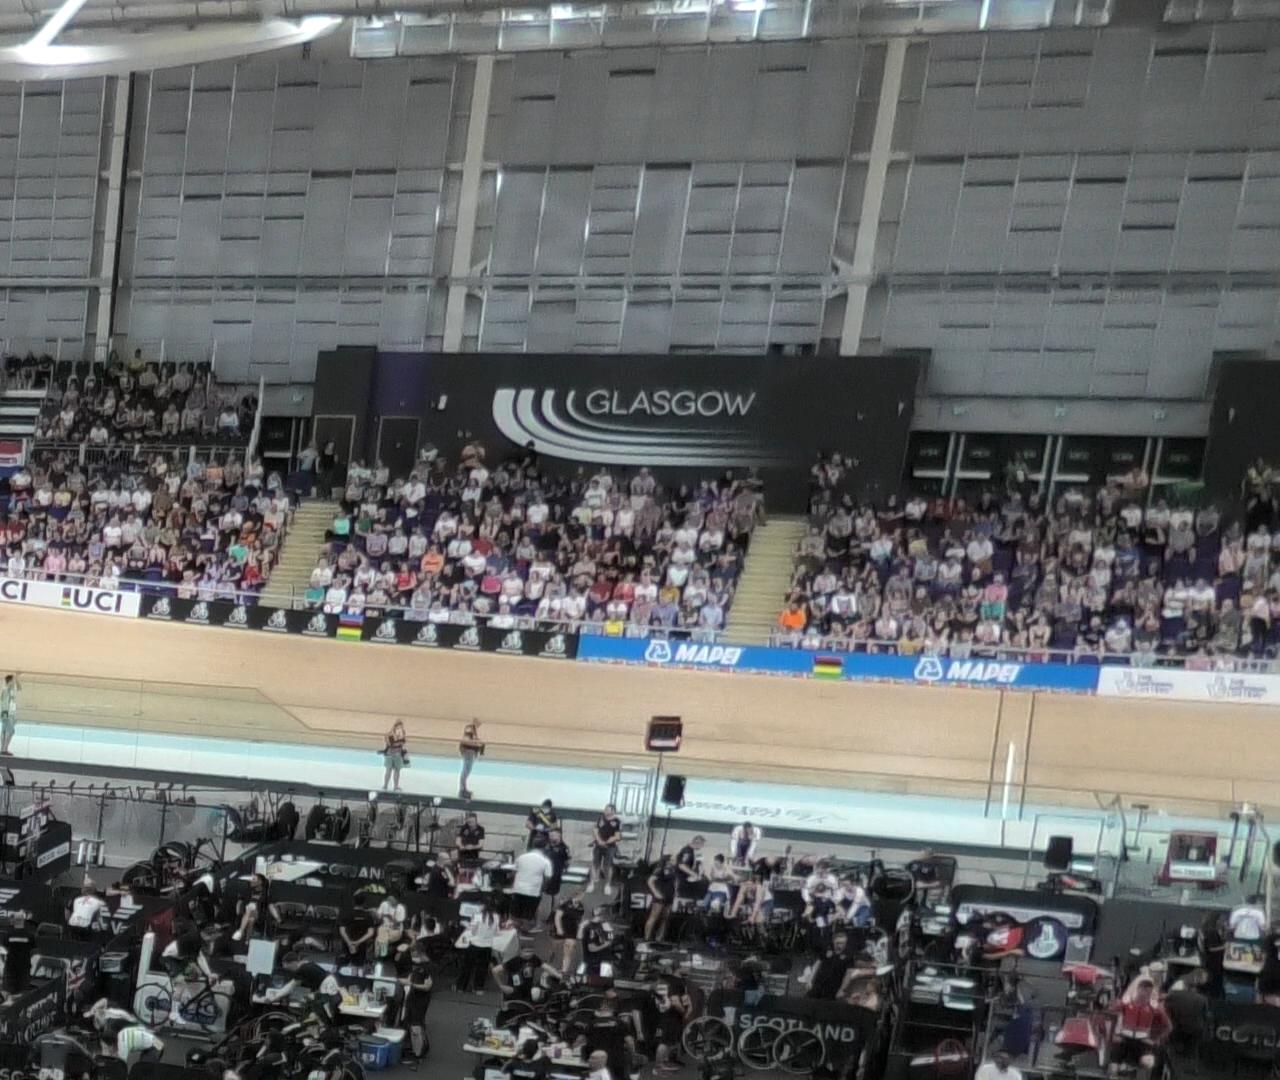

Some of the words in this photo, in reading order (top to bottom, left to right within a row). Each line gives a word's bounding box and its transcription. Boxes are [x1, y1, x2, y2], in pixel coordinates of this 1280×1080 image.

[585, 390, 756, 417] GLASGOW
[73, 589, 122, 613] UCI
[676, 643, 743, 665] MAPEI
[947, 661, 1021, 683] MAPEI
